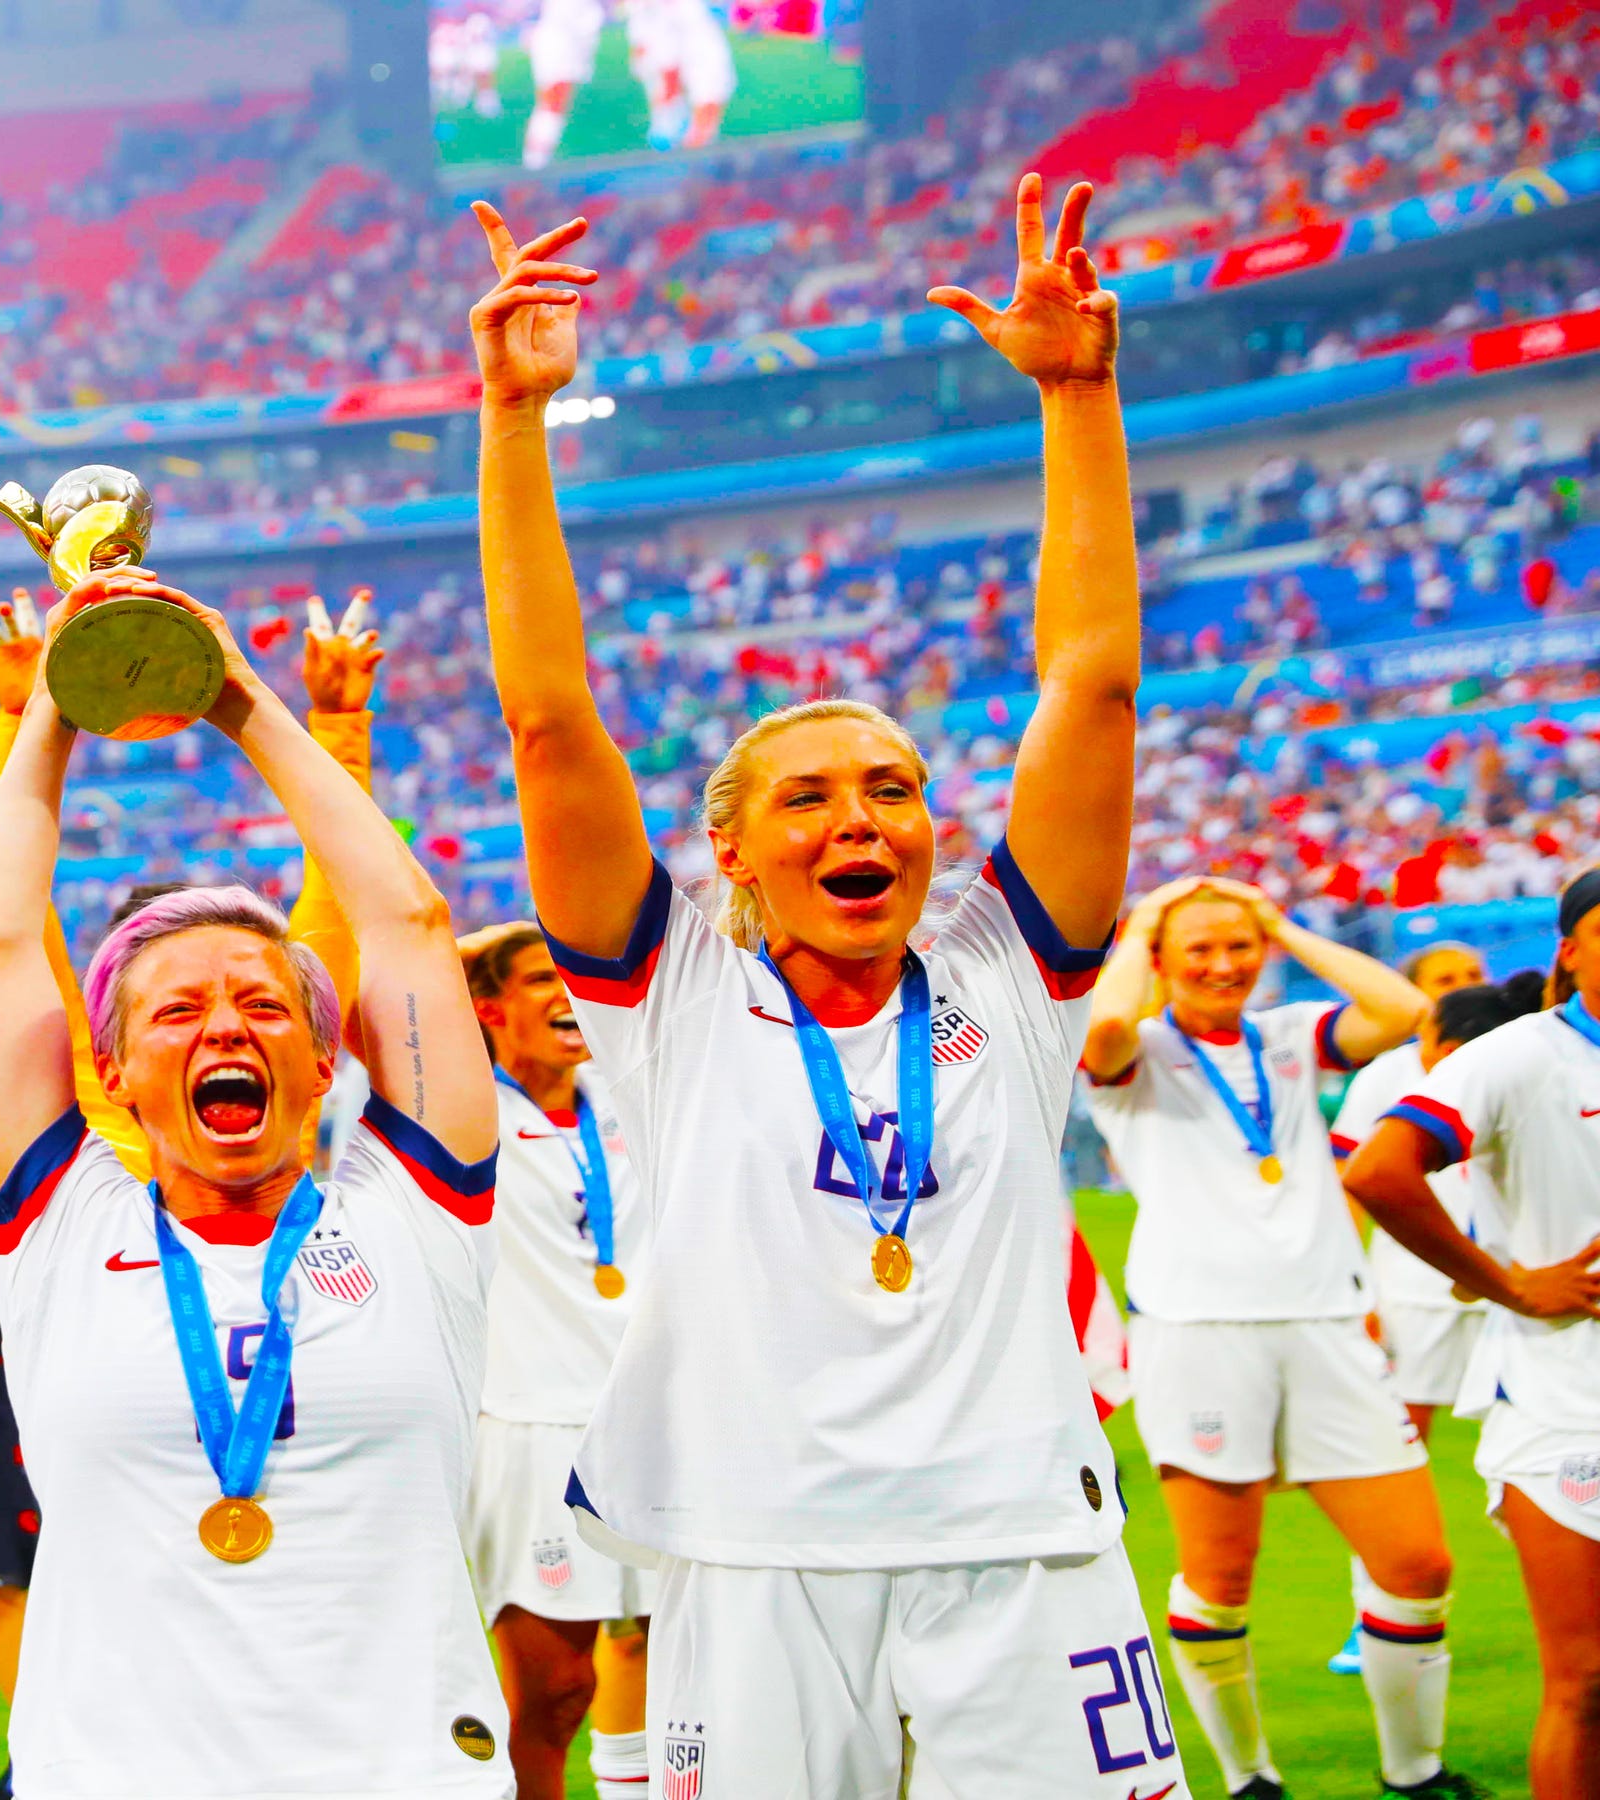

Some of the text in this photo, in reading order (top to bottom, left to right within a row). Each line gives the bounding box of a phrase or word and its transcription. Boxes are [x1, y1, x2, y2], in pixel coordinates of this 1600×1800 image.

[406, 1031, 420, 1049] her
[931, 1012, 964, 1042] SA
[301, 1246, 356, 1272] USA
[534, 1549, 568, 1566] USA
[1067, 1634, 1176, 1774] 20
[667, 1743, 700, 1772] USA
